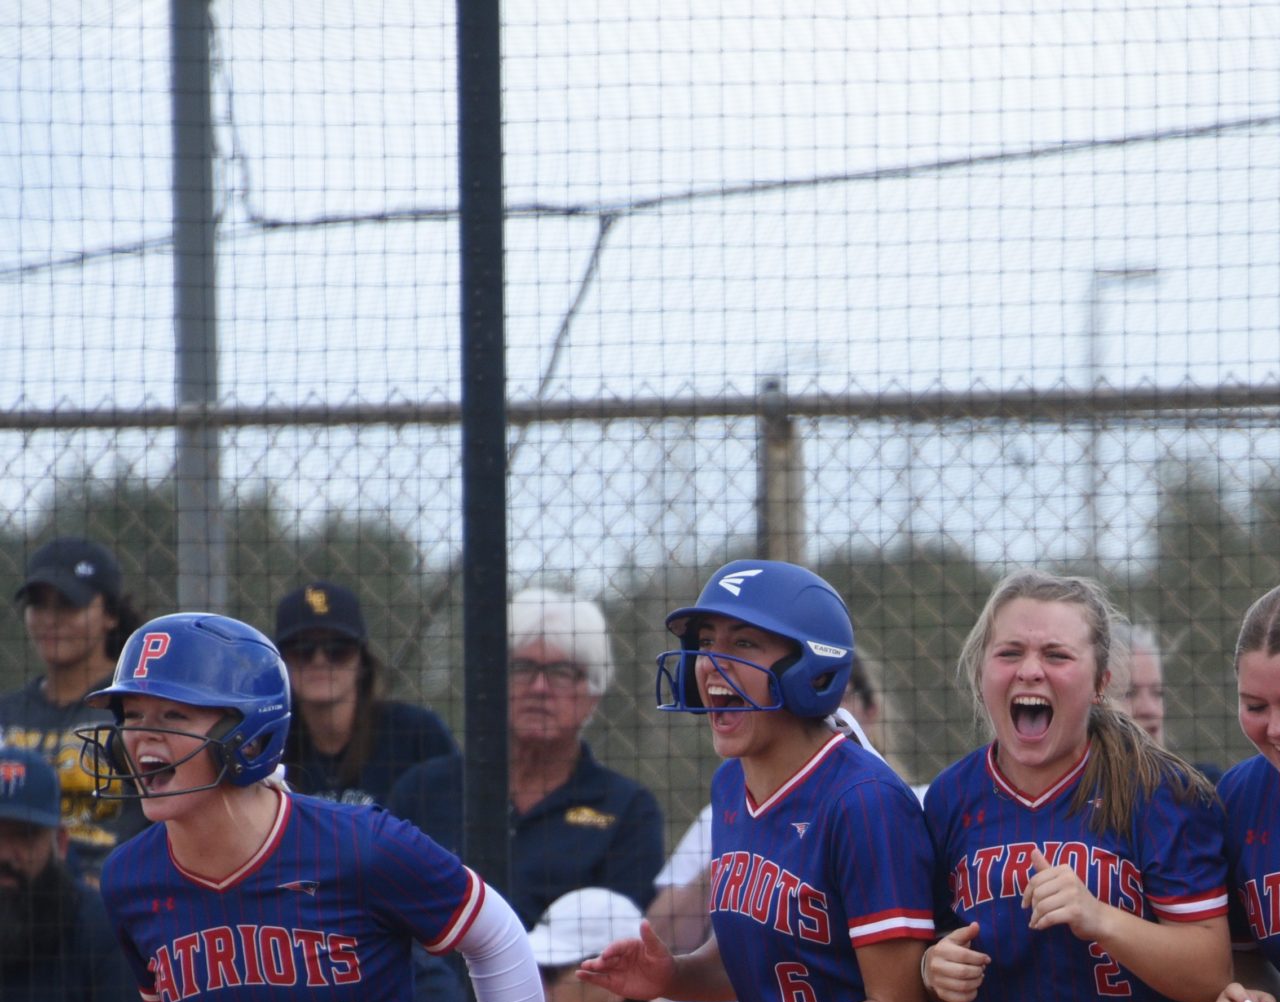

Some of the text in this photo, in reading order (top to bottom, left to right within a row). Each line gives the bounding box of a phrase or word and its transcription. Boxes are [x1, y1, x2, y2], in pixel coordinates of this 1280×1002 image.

[133, 632, 171, 678] P
[814, 644, 842, 655] EASTON
[710, 851, 831, 944] TRIOTS
[950, 841, 1144, 918] ATROTS
